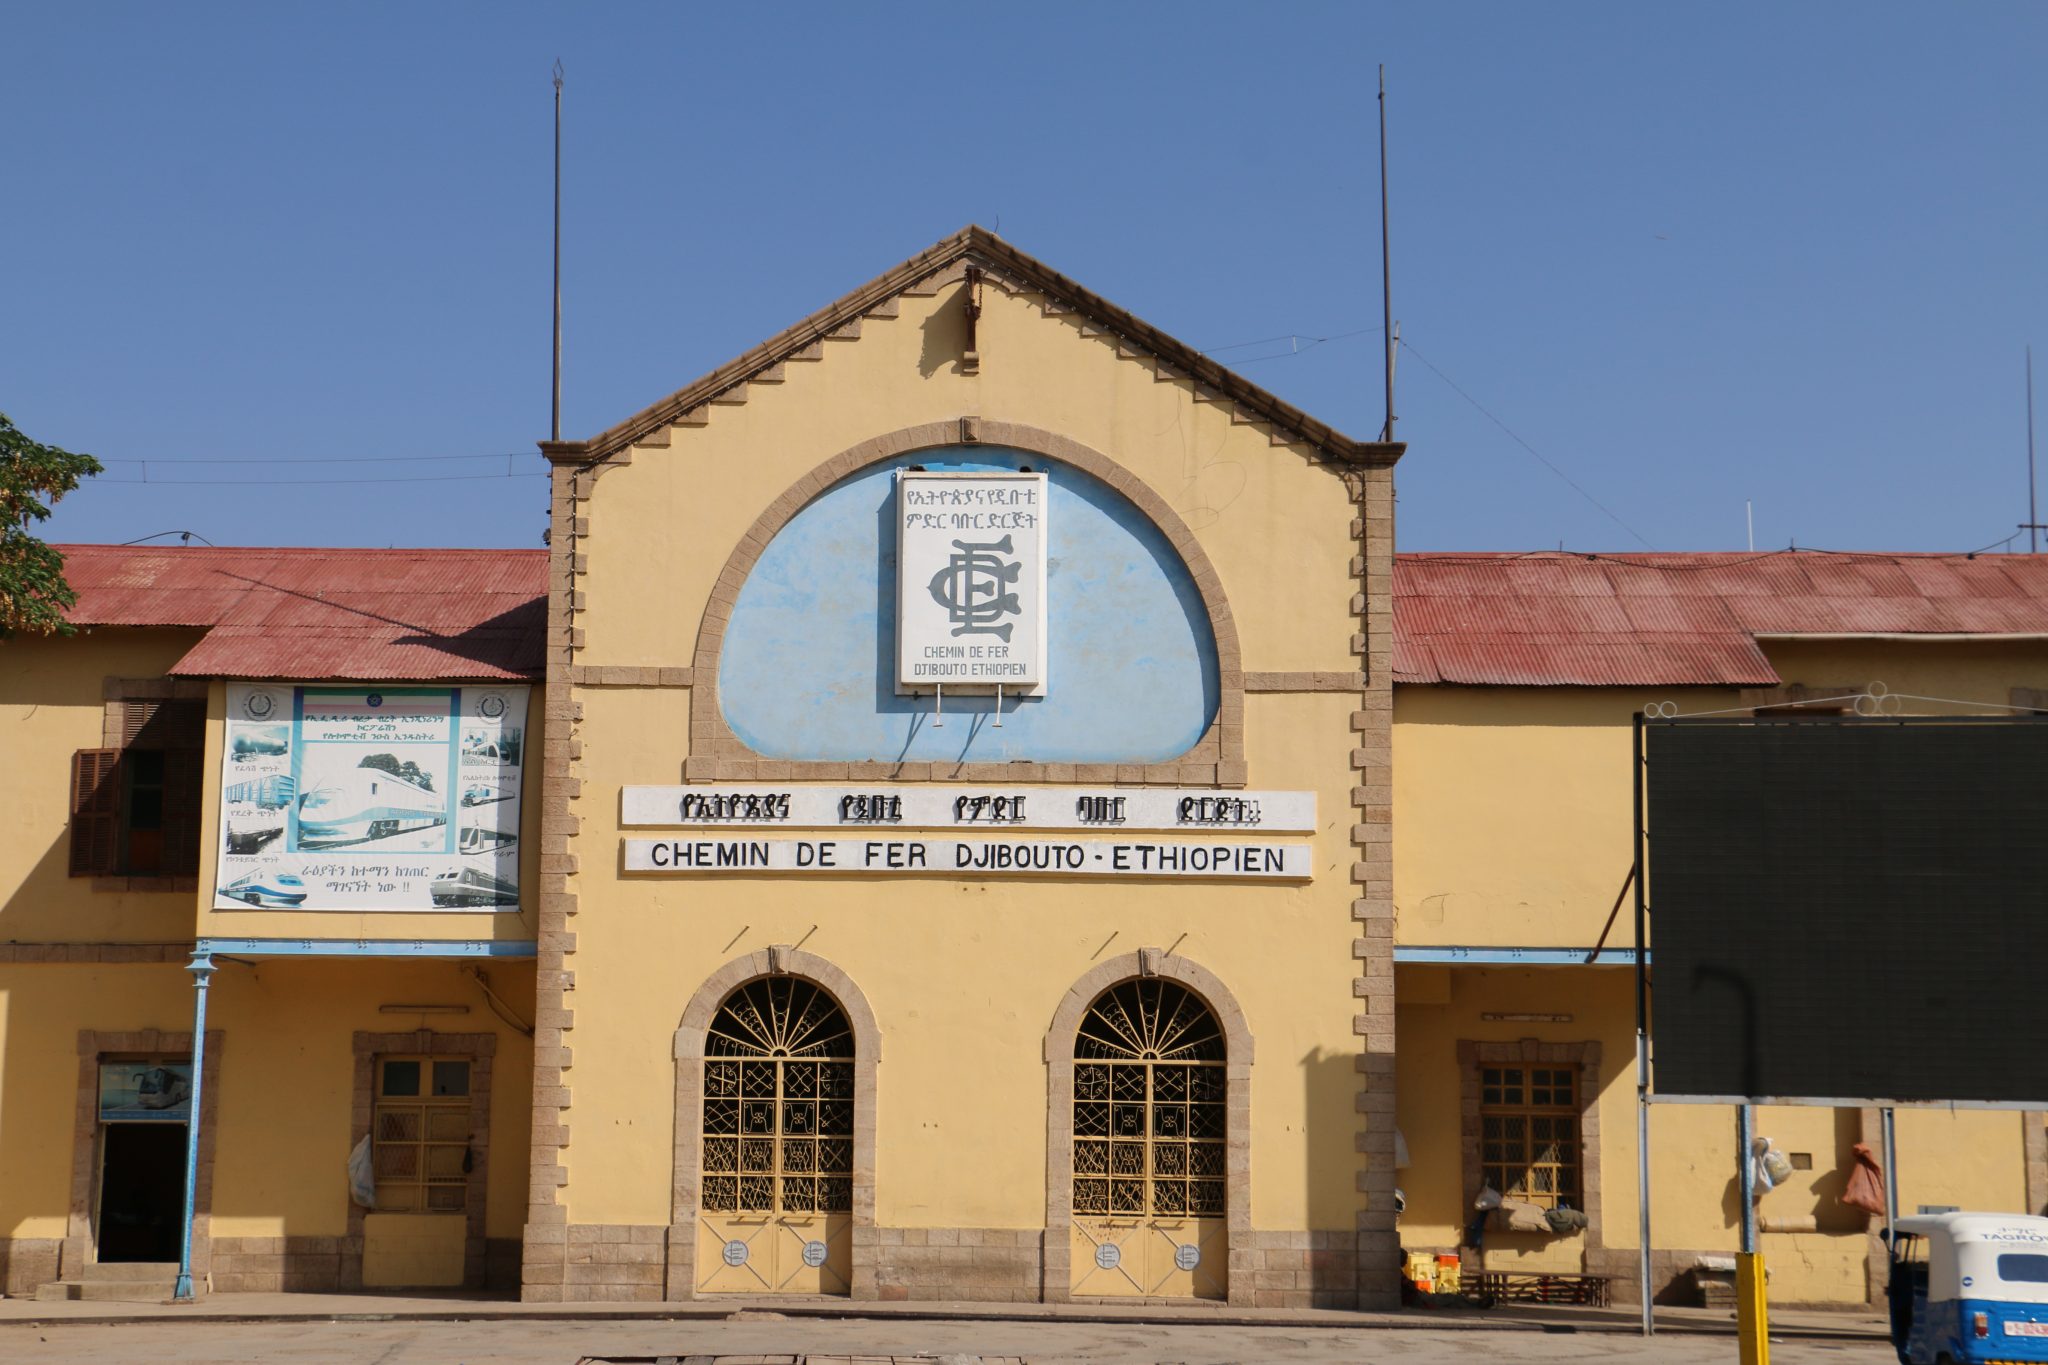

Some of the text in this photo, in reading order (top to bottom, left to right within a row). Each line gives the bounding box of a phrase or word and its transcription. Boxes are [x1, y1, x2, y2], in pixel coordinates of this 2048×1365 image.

[924, 646, 1009, 658] CHEMIN DE FER
[914, 663, 1026, 676] DJIBOUTO ETHIOPIEN
[651, 842, 769, 867] CHEMIN
[796, 842, 836, 866] DE
[865, 842, 926, 867] FER
